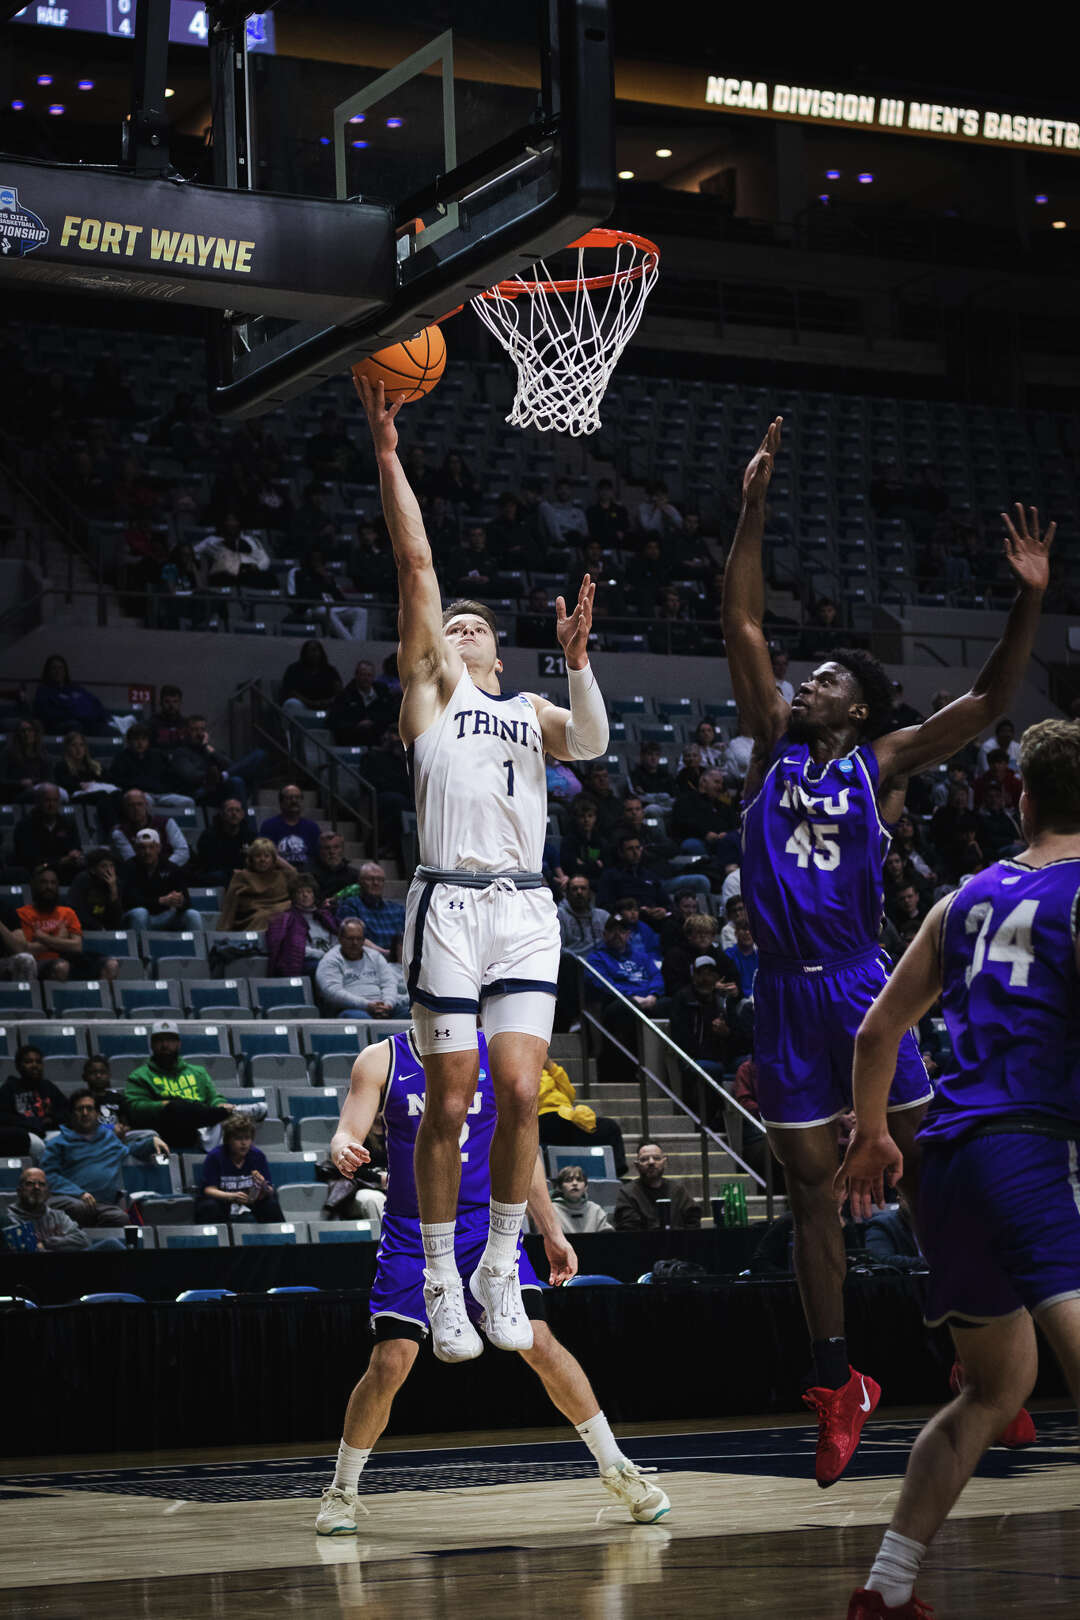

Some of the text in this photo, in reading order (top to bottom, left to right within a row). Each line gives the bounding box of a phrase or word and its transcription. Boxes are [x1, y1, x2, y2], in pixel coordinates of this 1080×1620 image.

[37, 6, 69, 26] HALF
[705, 76, 1080, 149] NCAA DIVISION III MEN'S BASKETB
[60, 215, 256, 273] FORT WAYNE
[503, 760, 514, 797] 1
[785, 821, 840, 871] 45
[406, 1091, 483, 1117] NU
